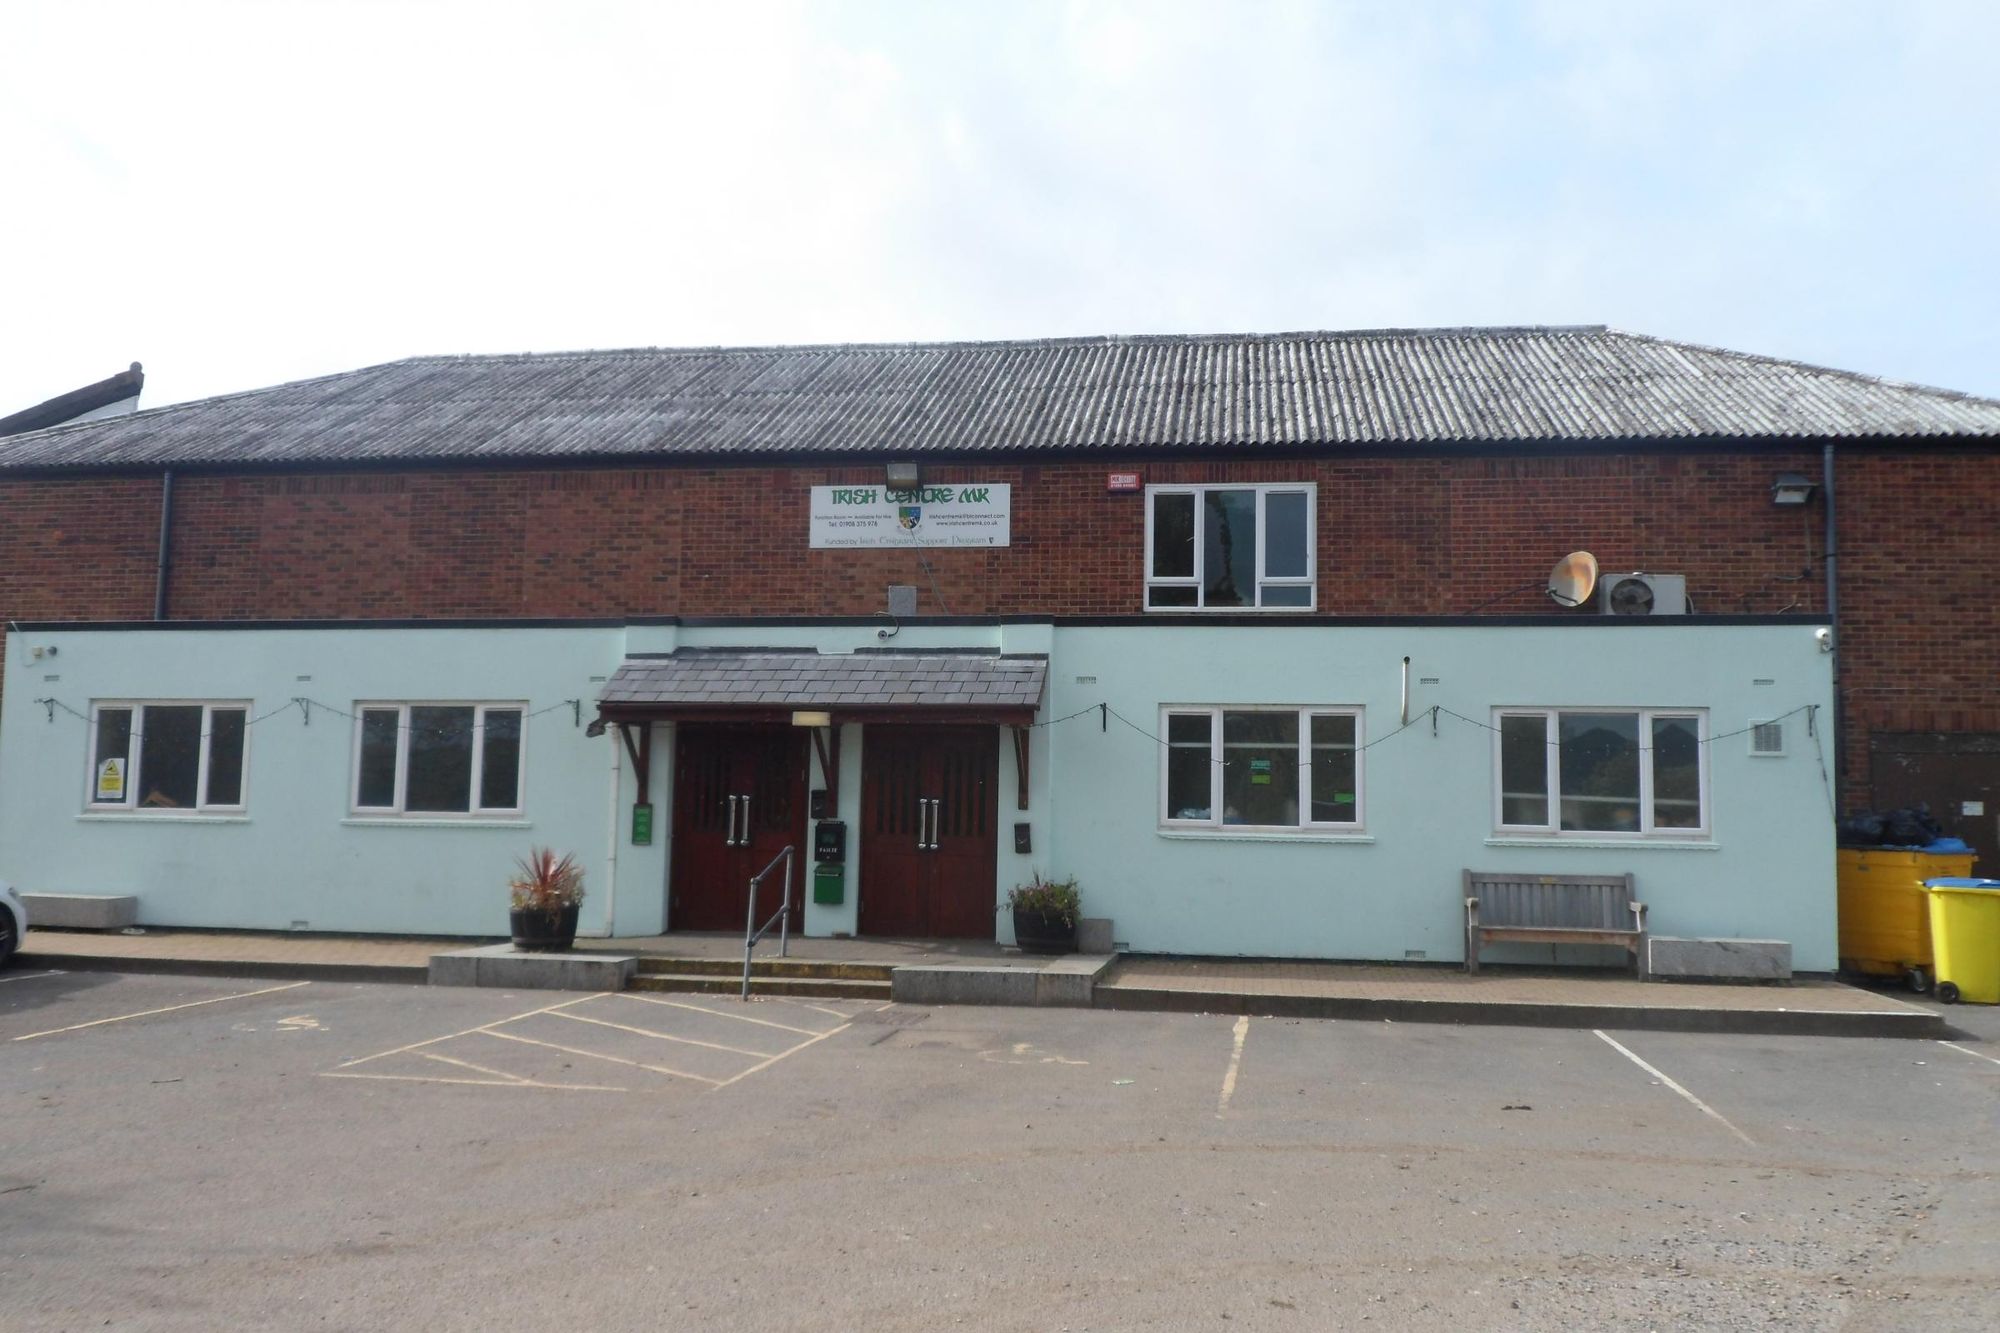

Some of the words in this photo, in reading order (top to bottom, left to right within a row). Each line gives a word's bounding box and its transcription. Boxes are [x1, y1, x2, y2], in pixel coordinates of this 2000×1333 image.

[832, 489, 878, 505] IRISH
[885, 487, 955, 505] CENTRE
[959, 488, 990, 504] MK
